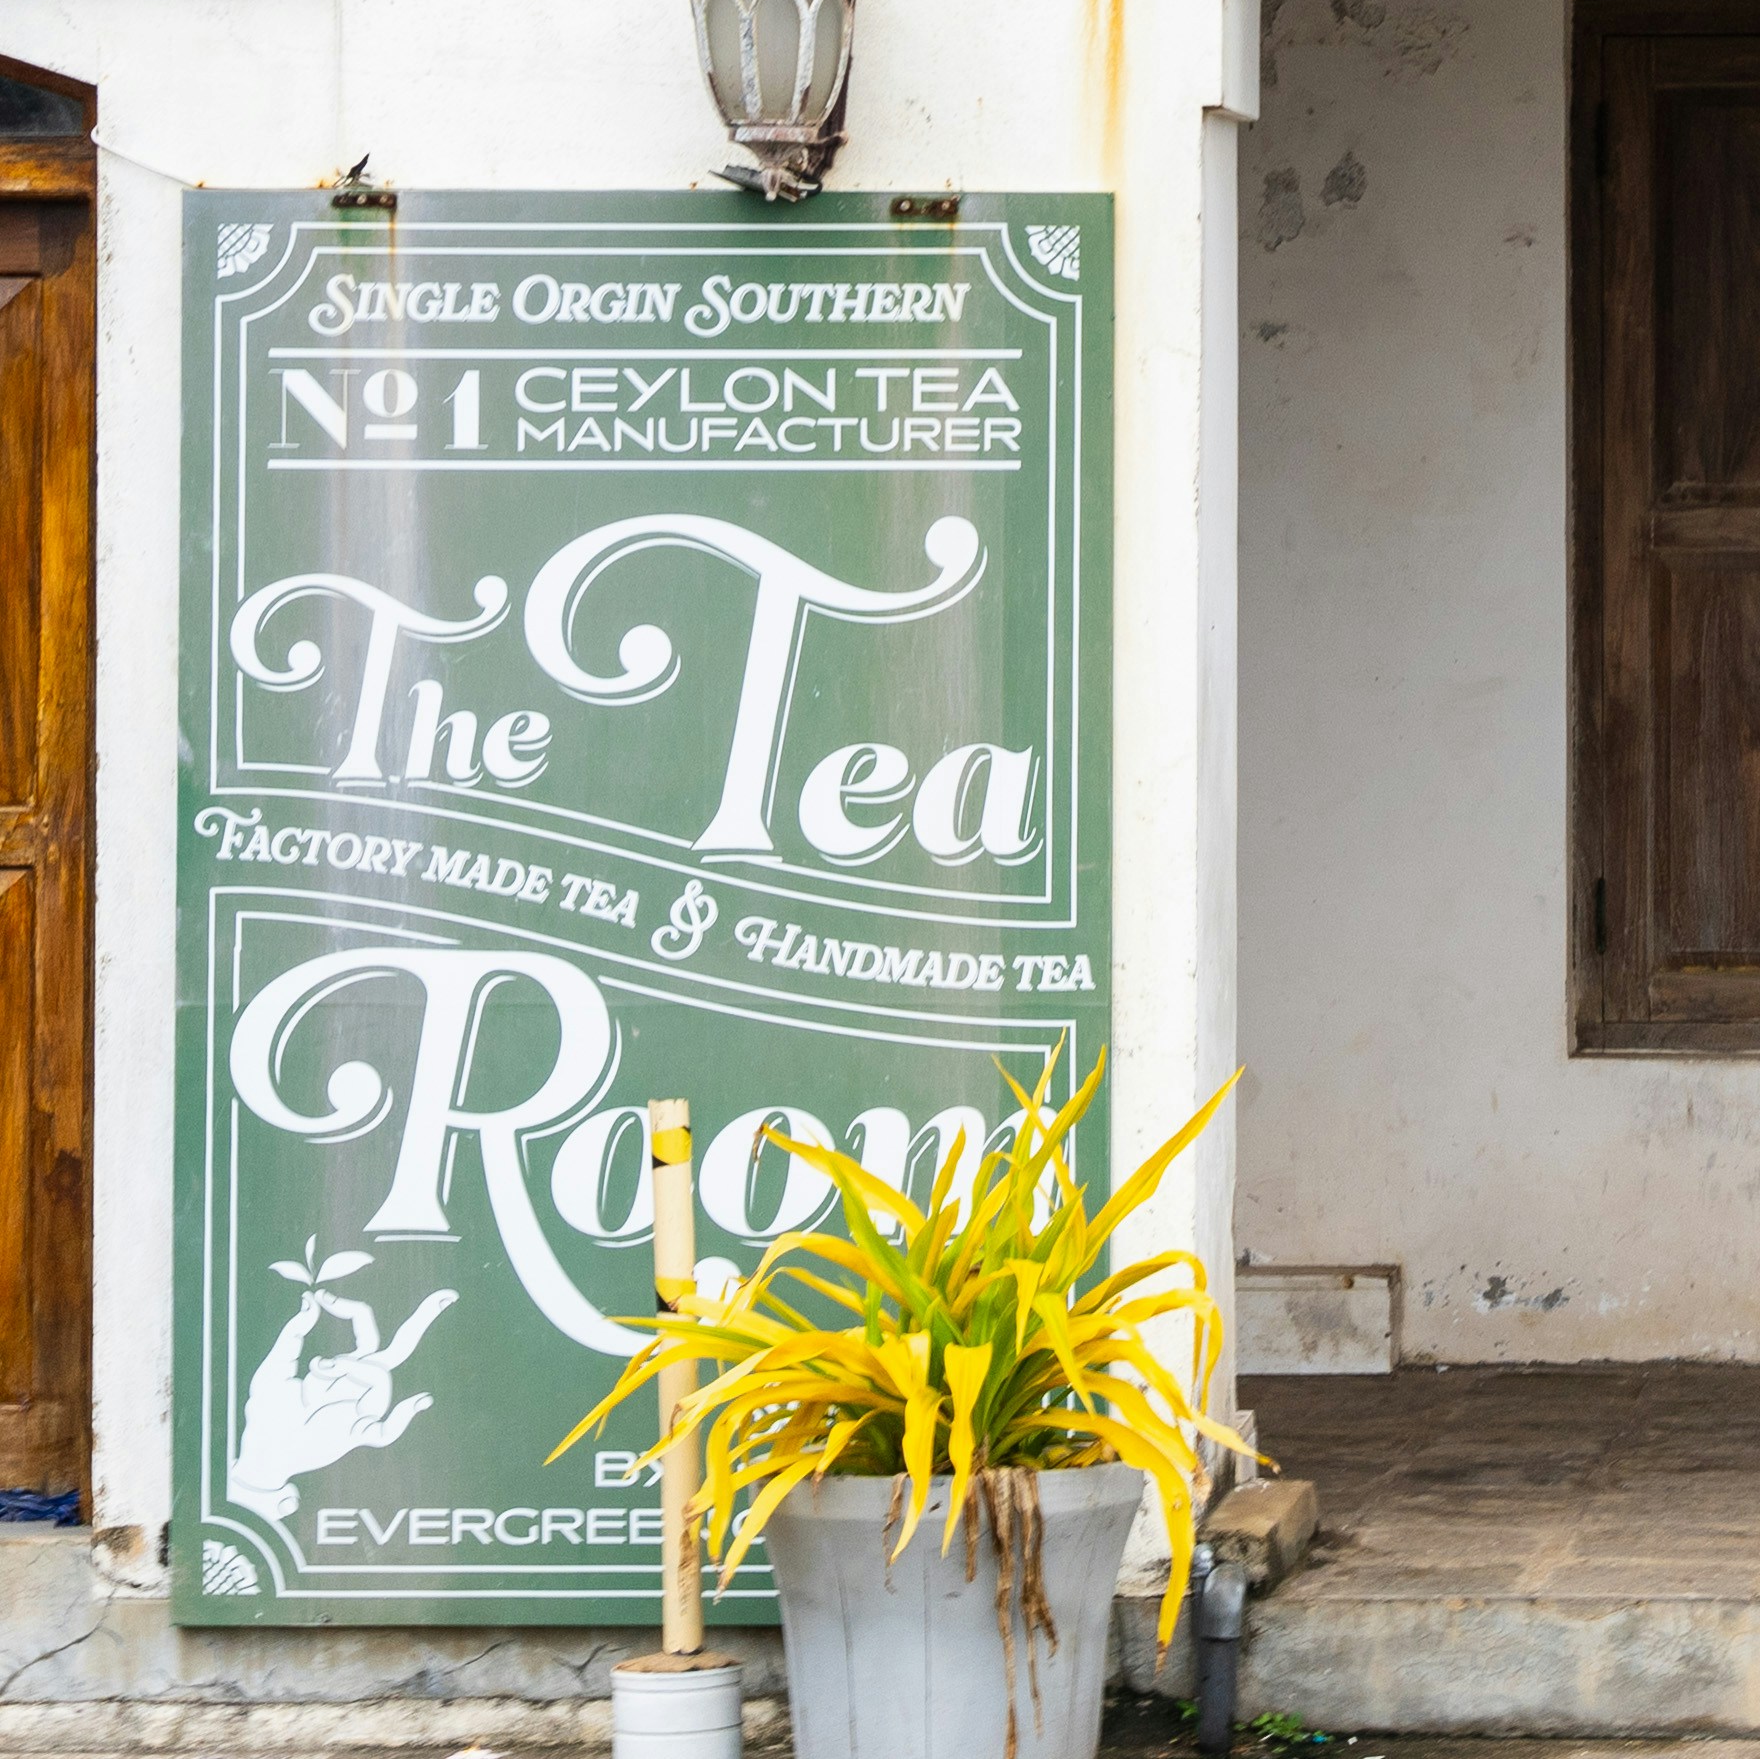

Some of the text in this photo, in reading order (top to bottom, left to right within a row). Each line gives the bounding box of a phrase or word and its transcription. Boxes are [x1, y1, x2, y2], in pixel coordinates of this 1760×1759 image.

[307, 273, 969, 339] SINGLE ORGIN SOUTHERN
[441, 369, 489, 451] 1
[514, 367, 1020, 414] CEYLON TEA
[515, 415, 1023, 454] MANUFACTURER
[229, 512, 1046, 868] The Tea
[194, 806, 1097, 994] FACTORY MADE TEA & HANDMADE TEA
[316, 1507, 714, 1545] EVERGREE
